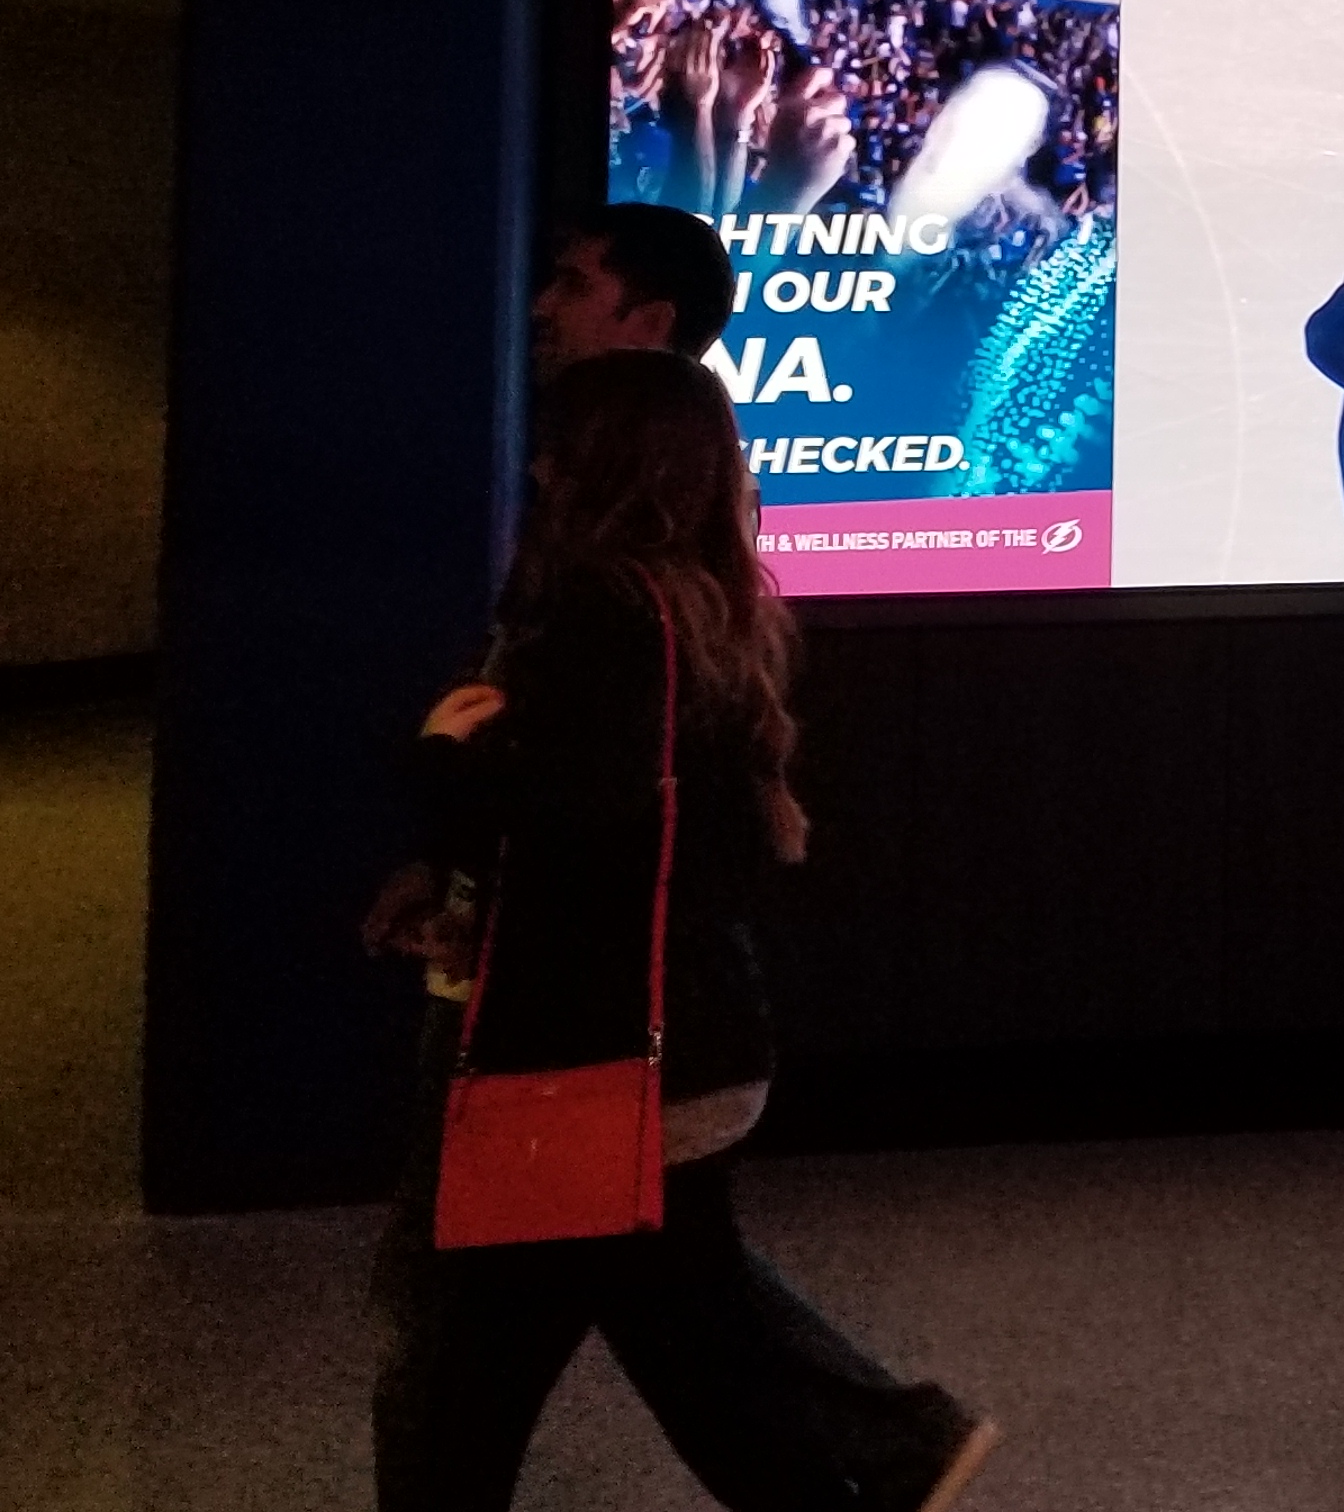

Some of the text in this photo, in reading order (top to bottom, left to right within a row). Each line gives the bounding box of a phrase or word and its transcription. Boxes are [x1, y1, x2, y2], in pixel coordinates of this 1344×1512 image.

[694, 213, 949, 256] HTNING
[762, 270, 896, 313] OUR
[738, 435, 970, 474] HECKED.
[793, 531, 890, 552] WELLNESS
[891, 530, 975, 550] PARTNER
[976, 529, 1000, 549] OF
[1002, 528, 1038, 548] THE
